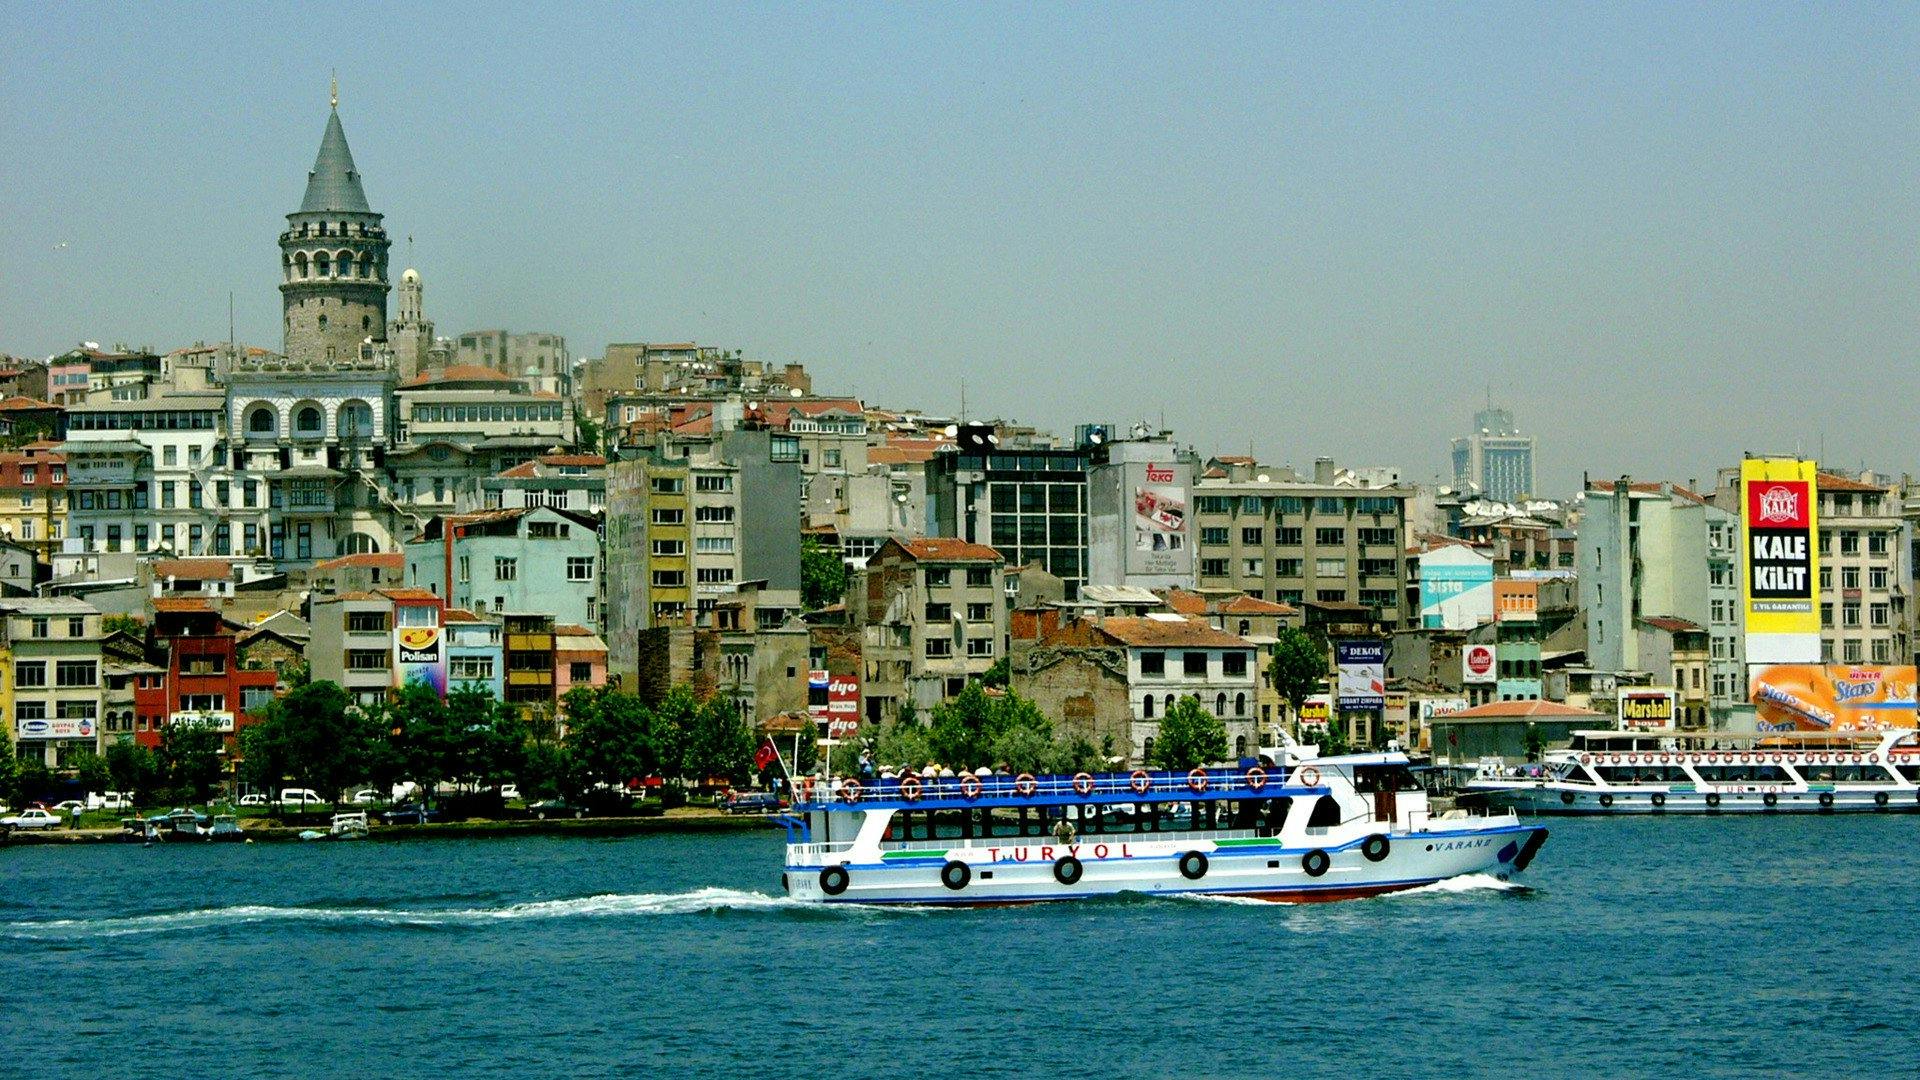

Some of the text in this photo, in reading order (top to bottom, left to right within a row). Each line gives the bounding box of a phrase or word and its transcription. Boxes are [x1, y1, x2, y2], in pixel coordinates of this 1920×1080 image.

[1146, 463, 1174, 482] Teka
[1763, 499, 1794, 515] KALE
[1754, 536, 1806, 560] KALE
[401, 651, 438, 661] Polisan
[829, 680, 857, 696] dyo
[1624, 699, 1670, 718] Marshall
[829, 718, 857, 736] dyo
